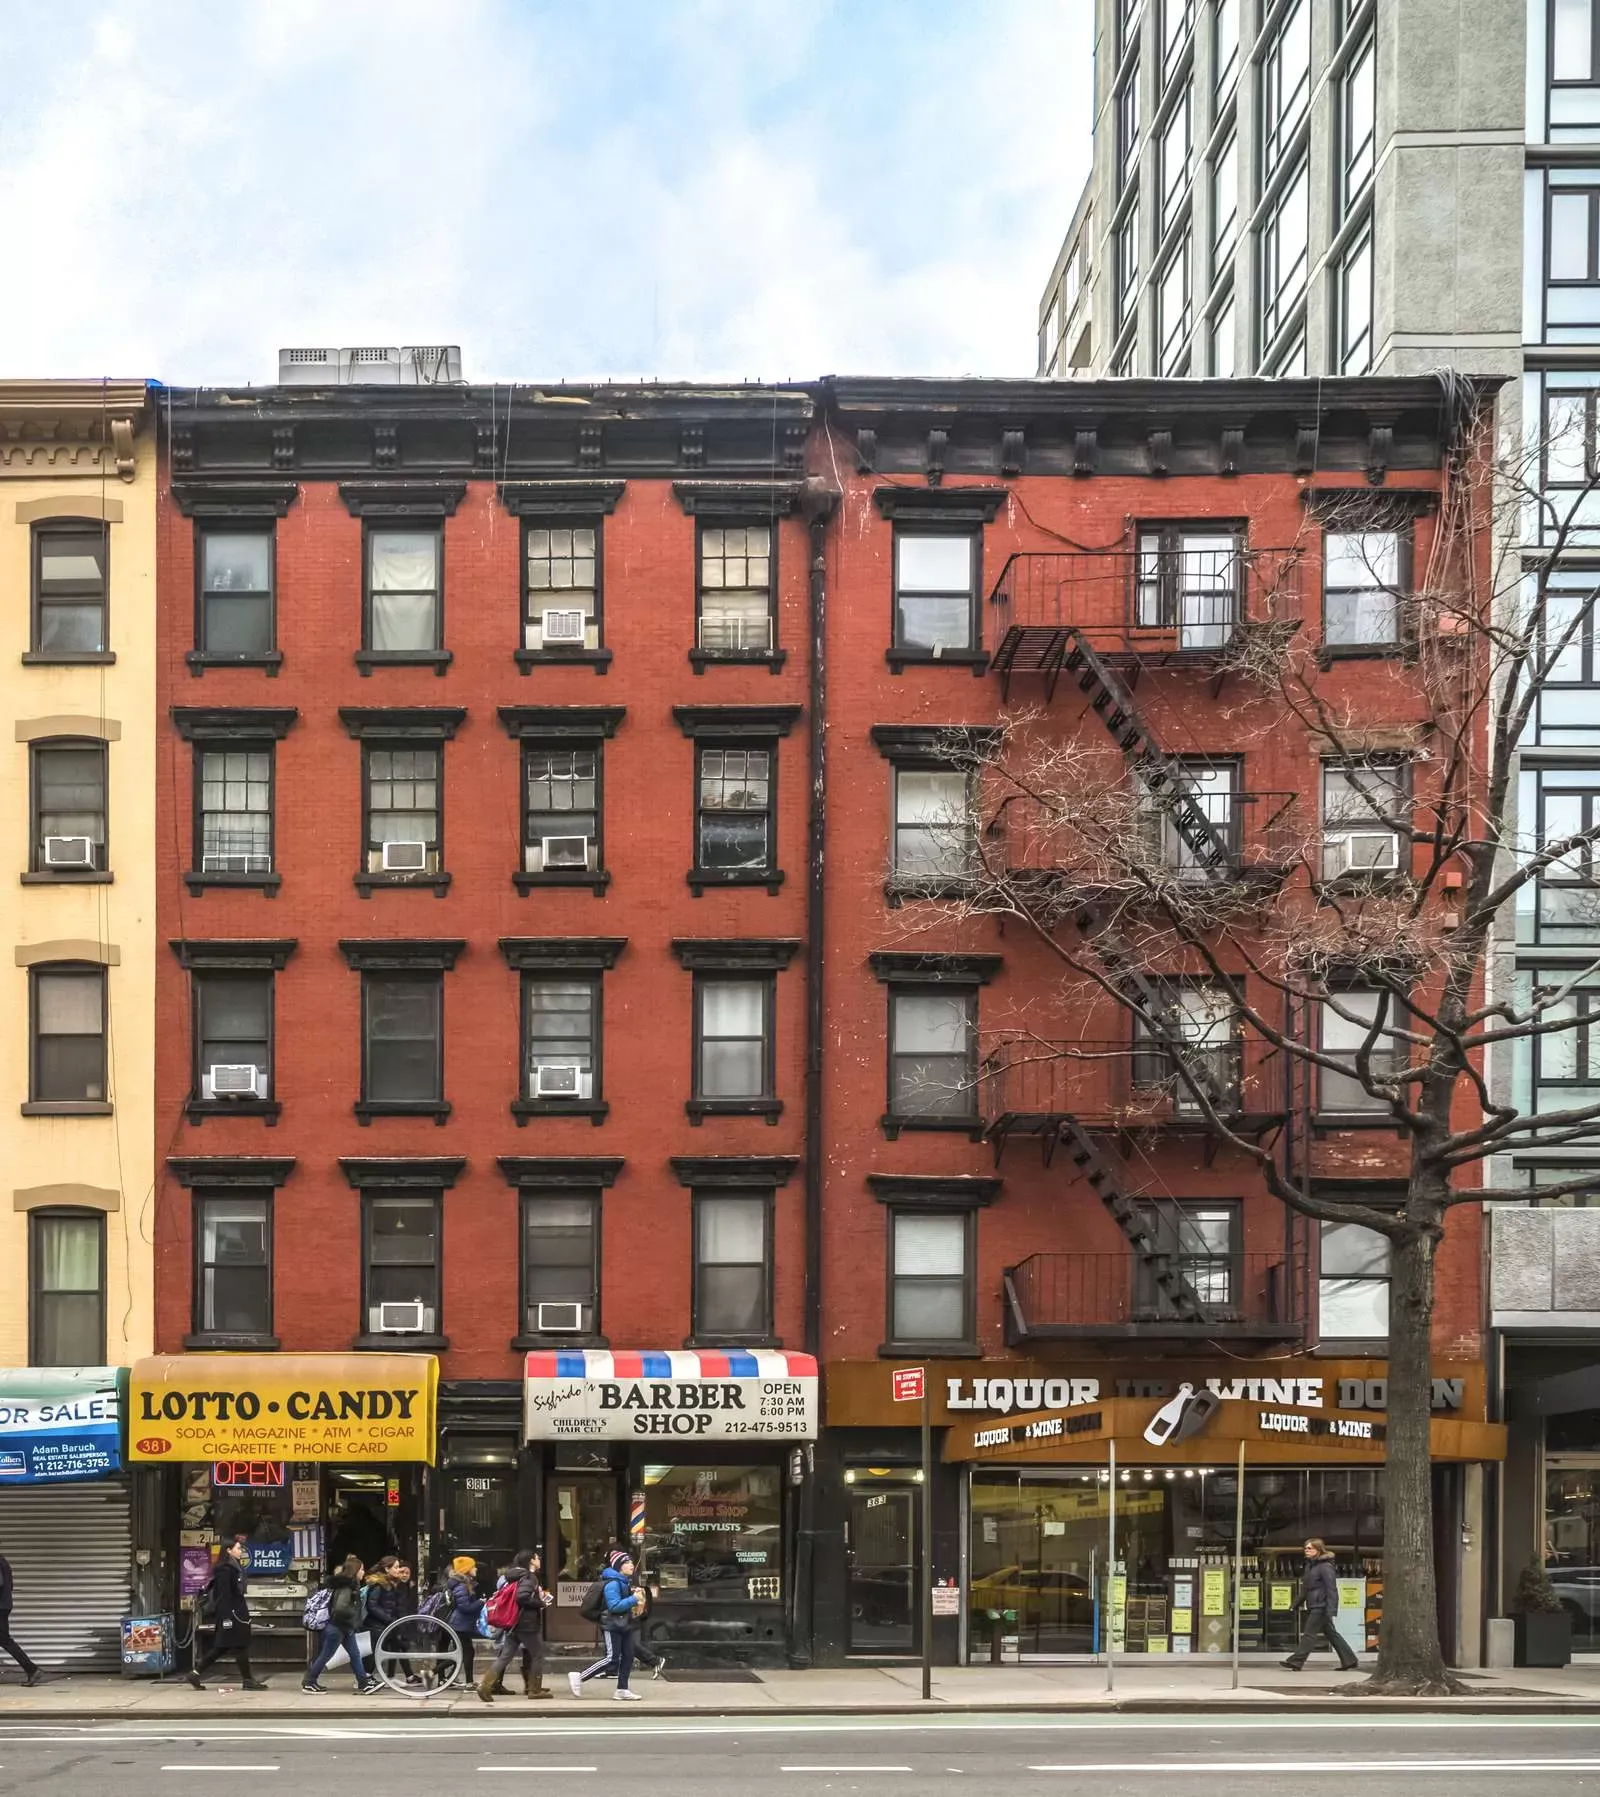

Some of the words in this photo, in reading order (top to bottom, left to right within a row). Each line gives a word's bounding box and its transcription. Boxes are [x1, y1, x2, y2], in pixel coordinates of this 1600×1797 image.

[763, 1383, 802, 1395] OPEN
[533, 1381, 596, 1411] Sigfrido's
[598, 1383, 746, 1410] BARBER
[760, 1397, 783, 1406] 7:30
[786, 1397, 805, 1406] AM
[947, 1378, 1100, 1414] LIQUOR
[1206, 1378, 1323, 1408] WINE
[1338, 1378, 1465, 1408] DON
[38, 1400, 104, 1422] SALE
[140, 1391, 260, 1421] LOTTO
[286, 1390, 419, 1421] CANDY
[760, 1407, 783, 1416] 6:00
[787, 1407, 805, 1416] PM
[553, 1419, 607, 1427] CHILDREN'S
[633, 1413, 713, 1434] SHOP
[725, 1422, 807, 1433] 212-475-9513
[1260, 1412, 1309, 1433] LIQUOR
[1329, 1421, 1337, 1433] &
[1337, 1420, 1372, 1438] WINE
[175, 1427, 216, 1439] SODA
[232, 1427, 306, 1439] MAGAZINE
[323, 1427, 351, 1438] ATM
[368, 1426, 415, 1438] CIGAR
[974, 1427, 1009, 1448] LIQUOR
[1025, 1425, 1032, 1437] &
[1032, 1418, 1063, 1438] WINE
[32, 1446, 59, 1455] Adam
[61, 1442, 96, 1453] Baruch
[142, 1440, 166, 1452] 381
[202, 1443, 277, 1454] CIGARETTE
[294, 1443, 342, 1454] PHONE
[347, 1442, 388, 1454] CARD
[69, 1451, 107, 1459] SALESPERSON
[34, 1462, 44, 1471] +1
[47, 1458, 110, 1471] 212-716-3752
[215, 1460, 283, 1485] OPEN
[699, 1471, 717, 1480] 381
[867, 1495, 887, 1508] 383
[673, 1522, 741, 1533] HAIRSTYLISTS
[254, 1550, 282, 1559] PLAY
[254, 1560, 286, 1568] HERE.
